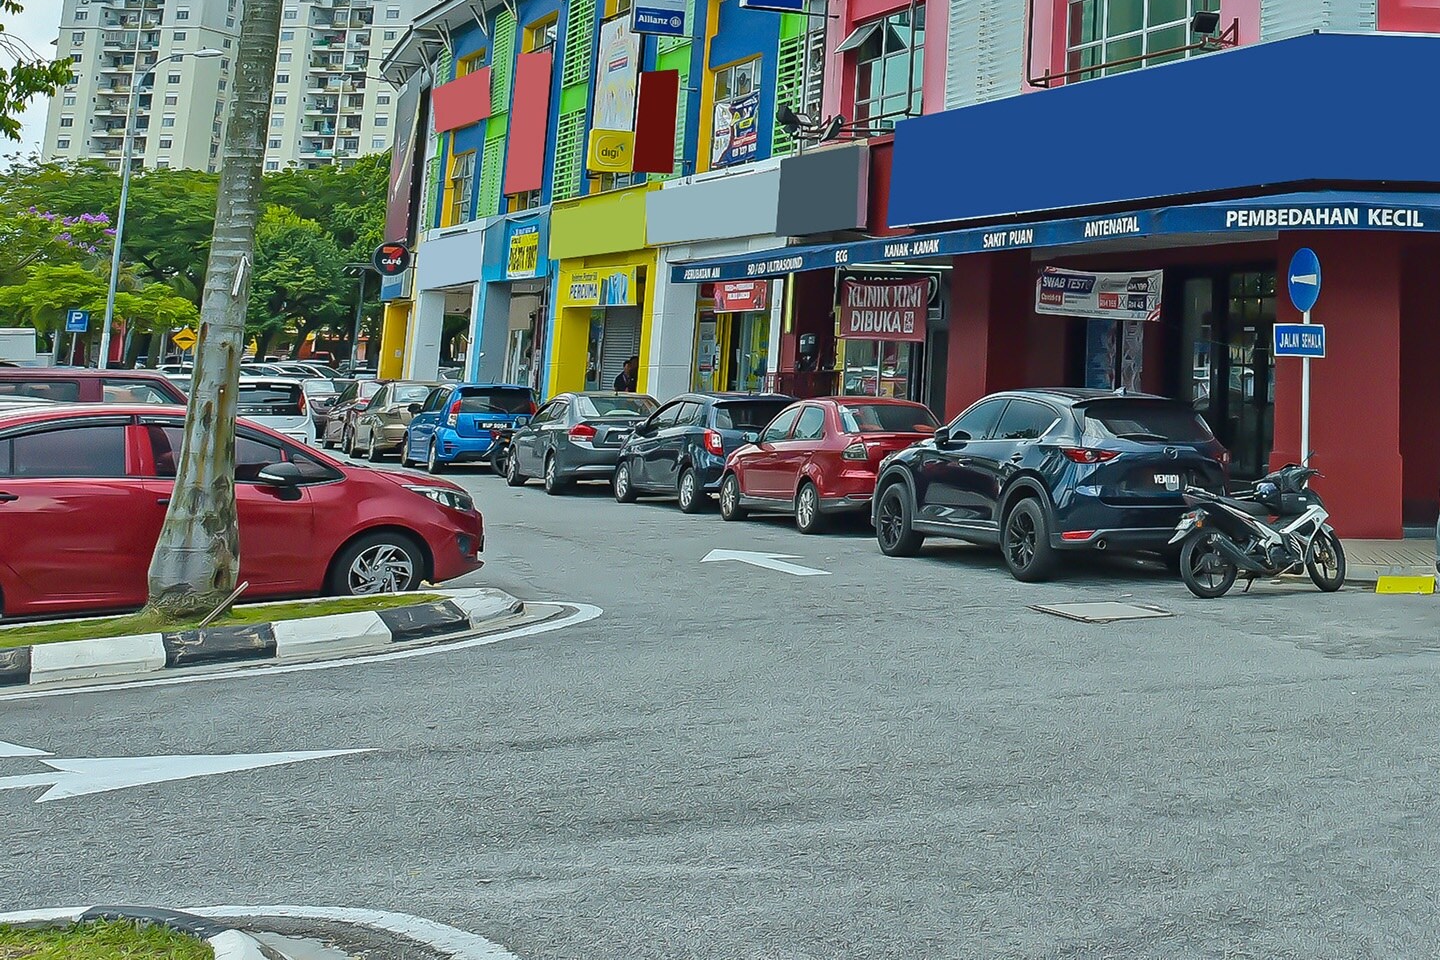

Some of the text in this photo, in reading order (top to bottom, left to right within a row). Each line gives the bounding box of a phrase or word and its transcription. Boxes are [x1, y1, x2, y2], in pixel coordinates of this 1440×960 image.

[638, 14, 668, 26] Allianz
[601, 147, 620, 160] digi
[1226, 208, 1424, 228] PEMBEDAHAN KECIL
[1084, 216, 1140, 238] ANTENATAL
[983, 229, 1033, 248] SAKIT PUAN
[835, 250, 848, 263] ECG
[884, 243, 909, 258] KANAK
[913, 239, 939, 254] KANAK
[766, 256, 803, 273] ULTRASOUND
[683, 267, 721, 280] PERUBATAN AM
[1042, 276, 1066, 289] SWAB
[570, 283, 598, 299] PERCUMA
[848, 286, 921, 308] KLINIK KINI
[71, 312, 83, 323] P
[850, 311, 901, 333] DIBUKA
[1278, 333, 1322, 349] JALAN SEHALA
